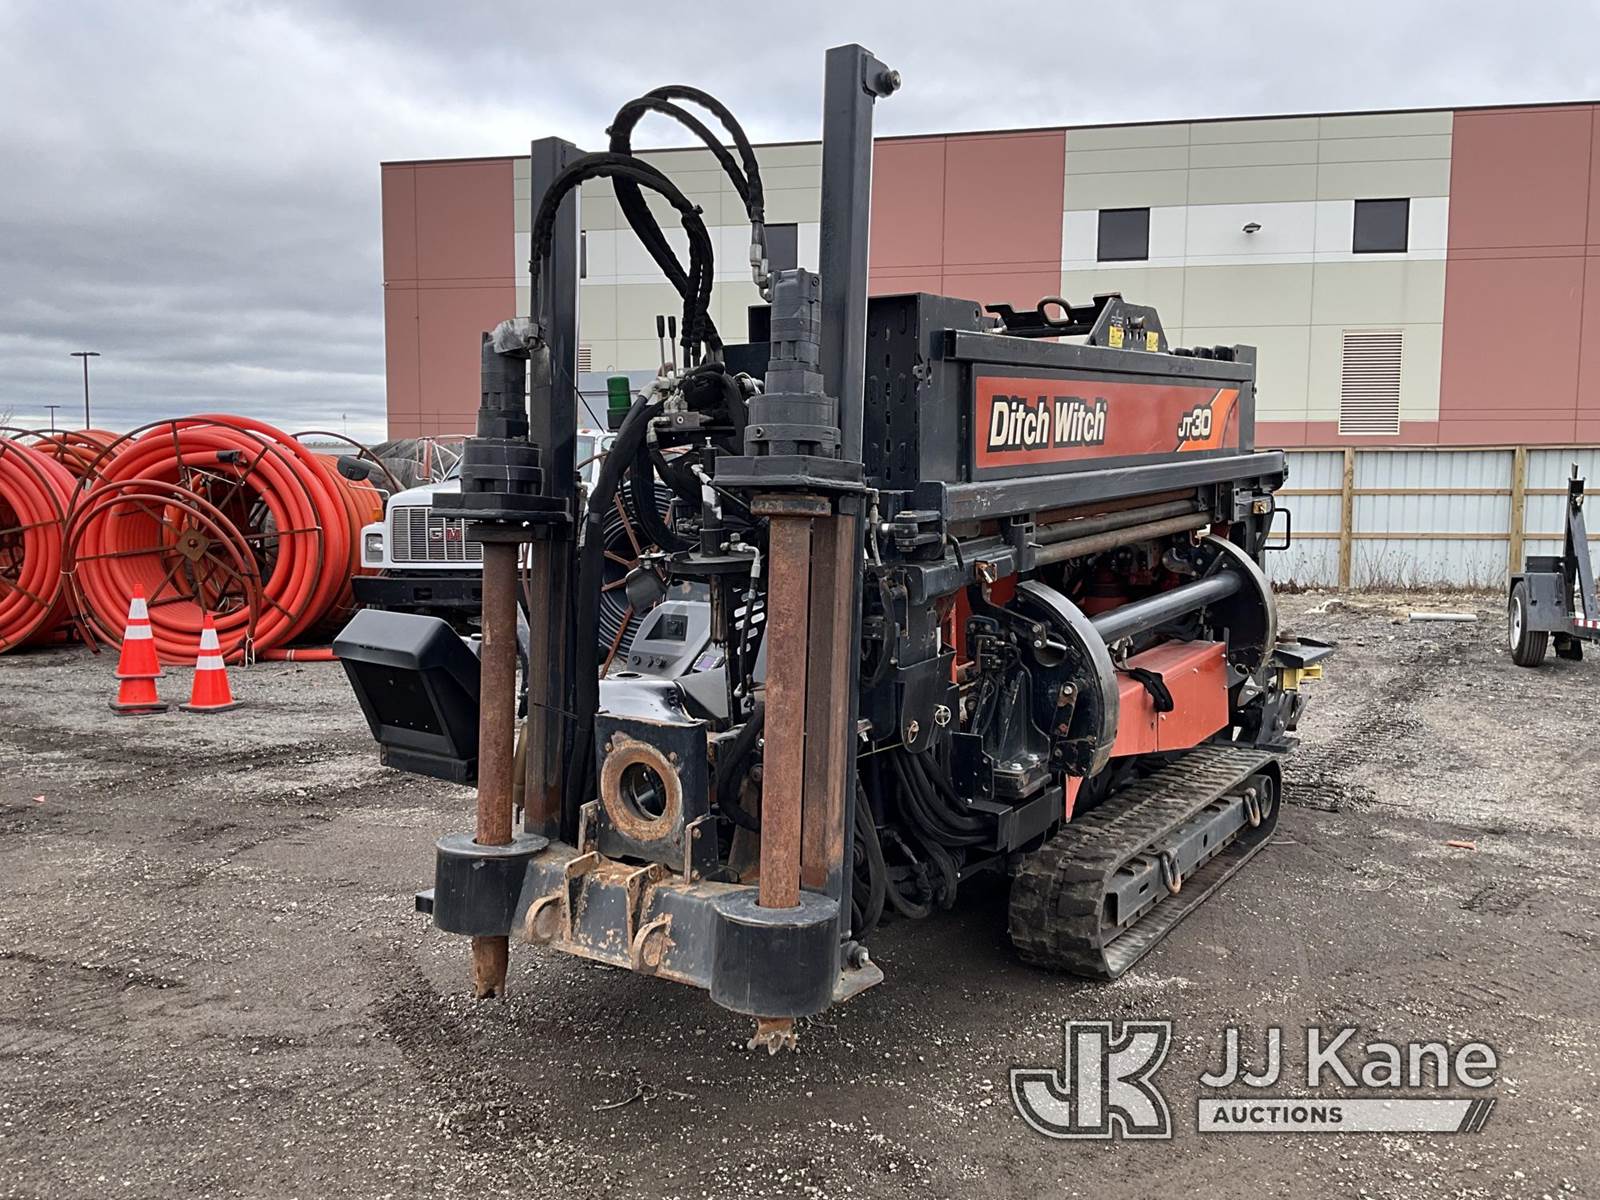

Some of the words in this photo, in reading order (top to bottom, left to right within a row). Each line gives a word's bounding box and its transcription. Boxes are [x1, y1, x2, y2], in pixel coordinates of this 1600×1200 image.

[988, 399, 1050, 448] Ditch
[1054, 399, 1106, 443] Witch
[1177, 408, 1212, 437] JT30
[429, 527, 469, 542] GM
